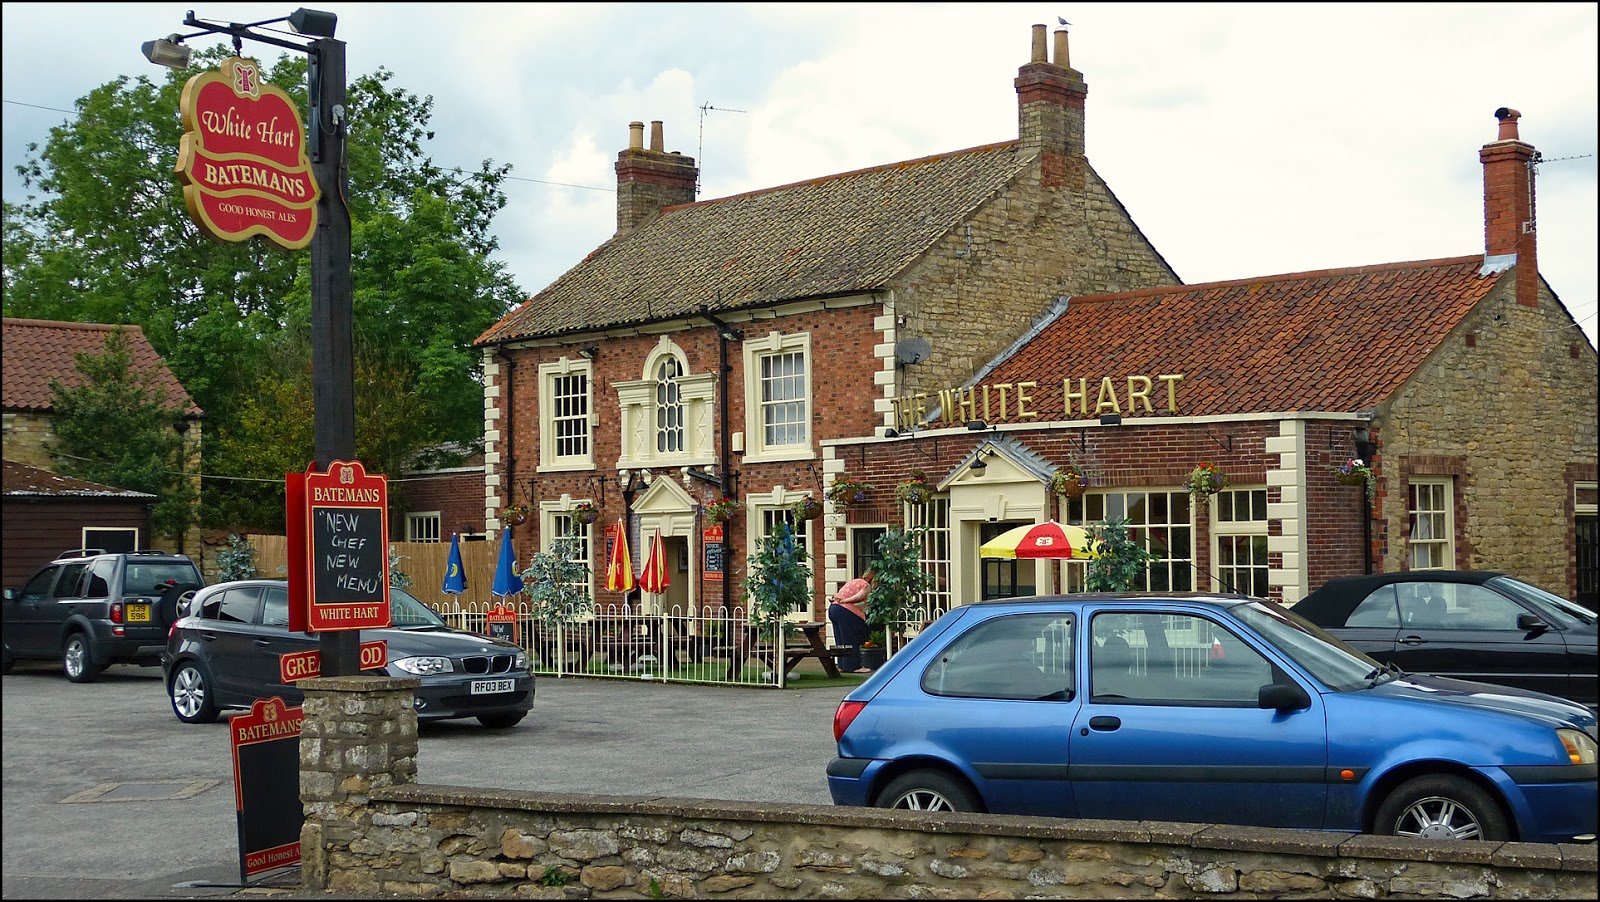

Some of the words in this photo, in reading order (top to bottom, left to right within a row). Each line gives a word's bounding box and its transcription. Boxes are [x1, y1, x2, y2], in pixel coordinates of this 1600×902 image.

[202, 106, 251, 140] White
[256, 116, 295, 148] Hart
[204, 164, 305, 197] BATEMANS
[218, 202, 244, 215] GOOD
[245, 206, 276, 220] HONEST
[278, 212, 297, 223] ALES
[890, 392, 929, 432] THE
[938, 381, 1038, 425] WHITE
[1063, 374, 1184, 416] HART
[314, 487, 380, 503] BATEMANS
[331, 534, 367, 550] CHEF
[326, 554, 360, 571] NEW
[319, 607, 351, 620] WHITE
[353, 606, 379, 619] HART
[286, 656, 321, 677] GRE
[360, 646, 382, 665] OD
[474, 681, 497, 692] RF03
[498, 680, 512, 691] BEX
[239, 718, 302, 741] BATEMANS
[247, 854, 266, 868] Good
[268, 849, 293, 863] Honest
